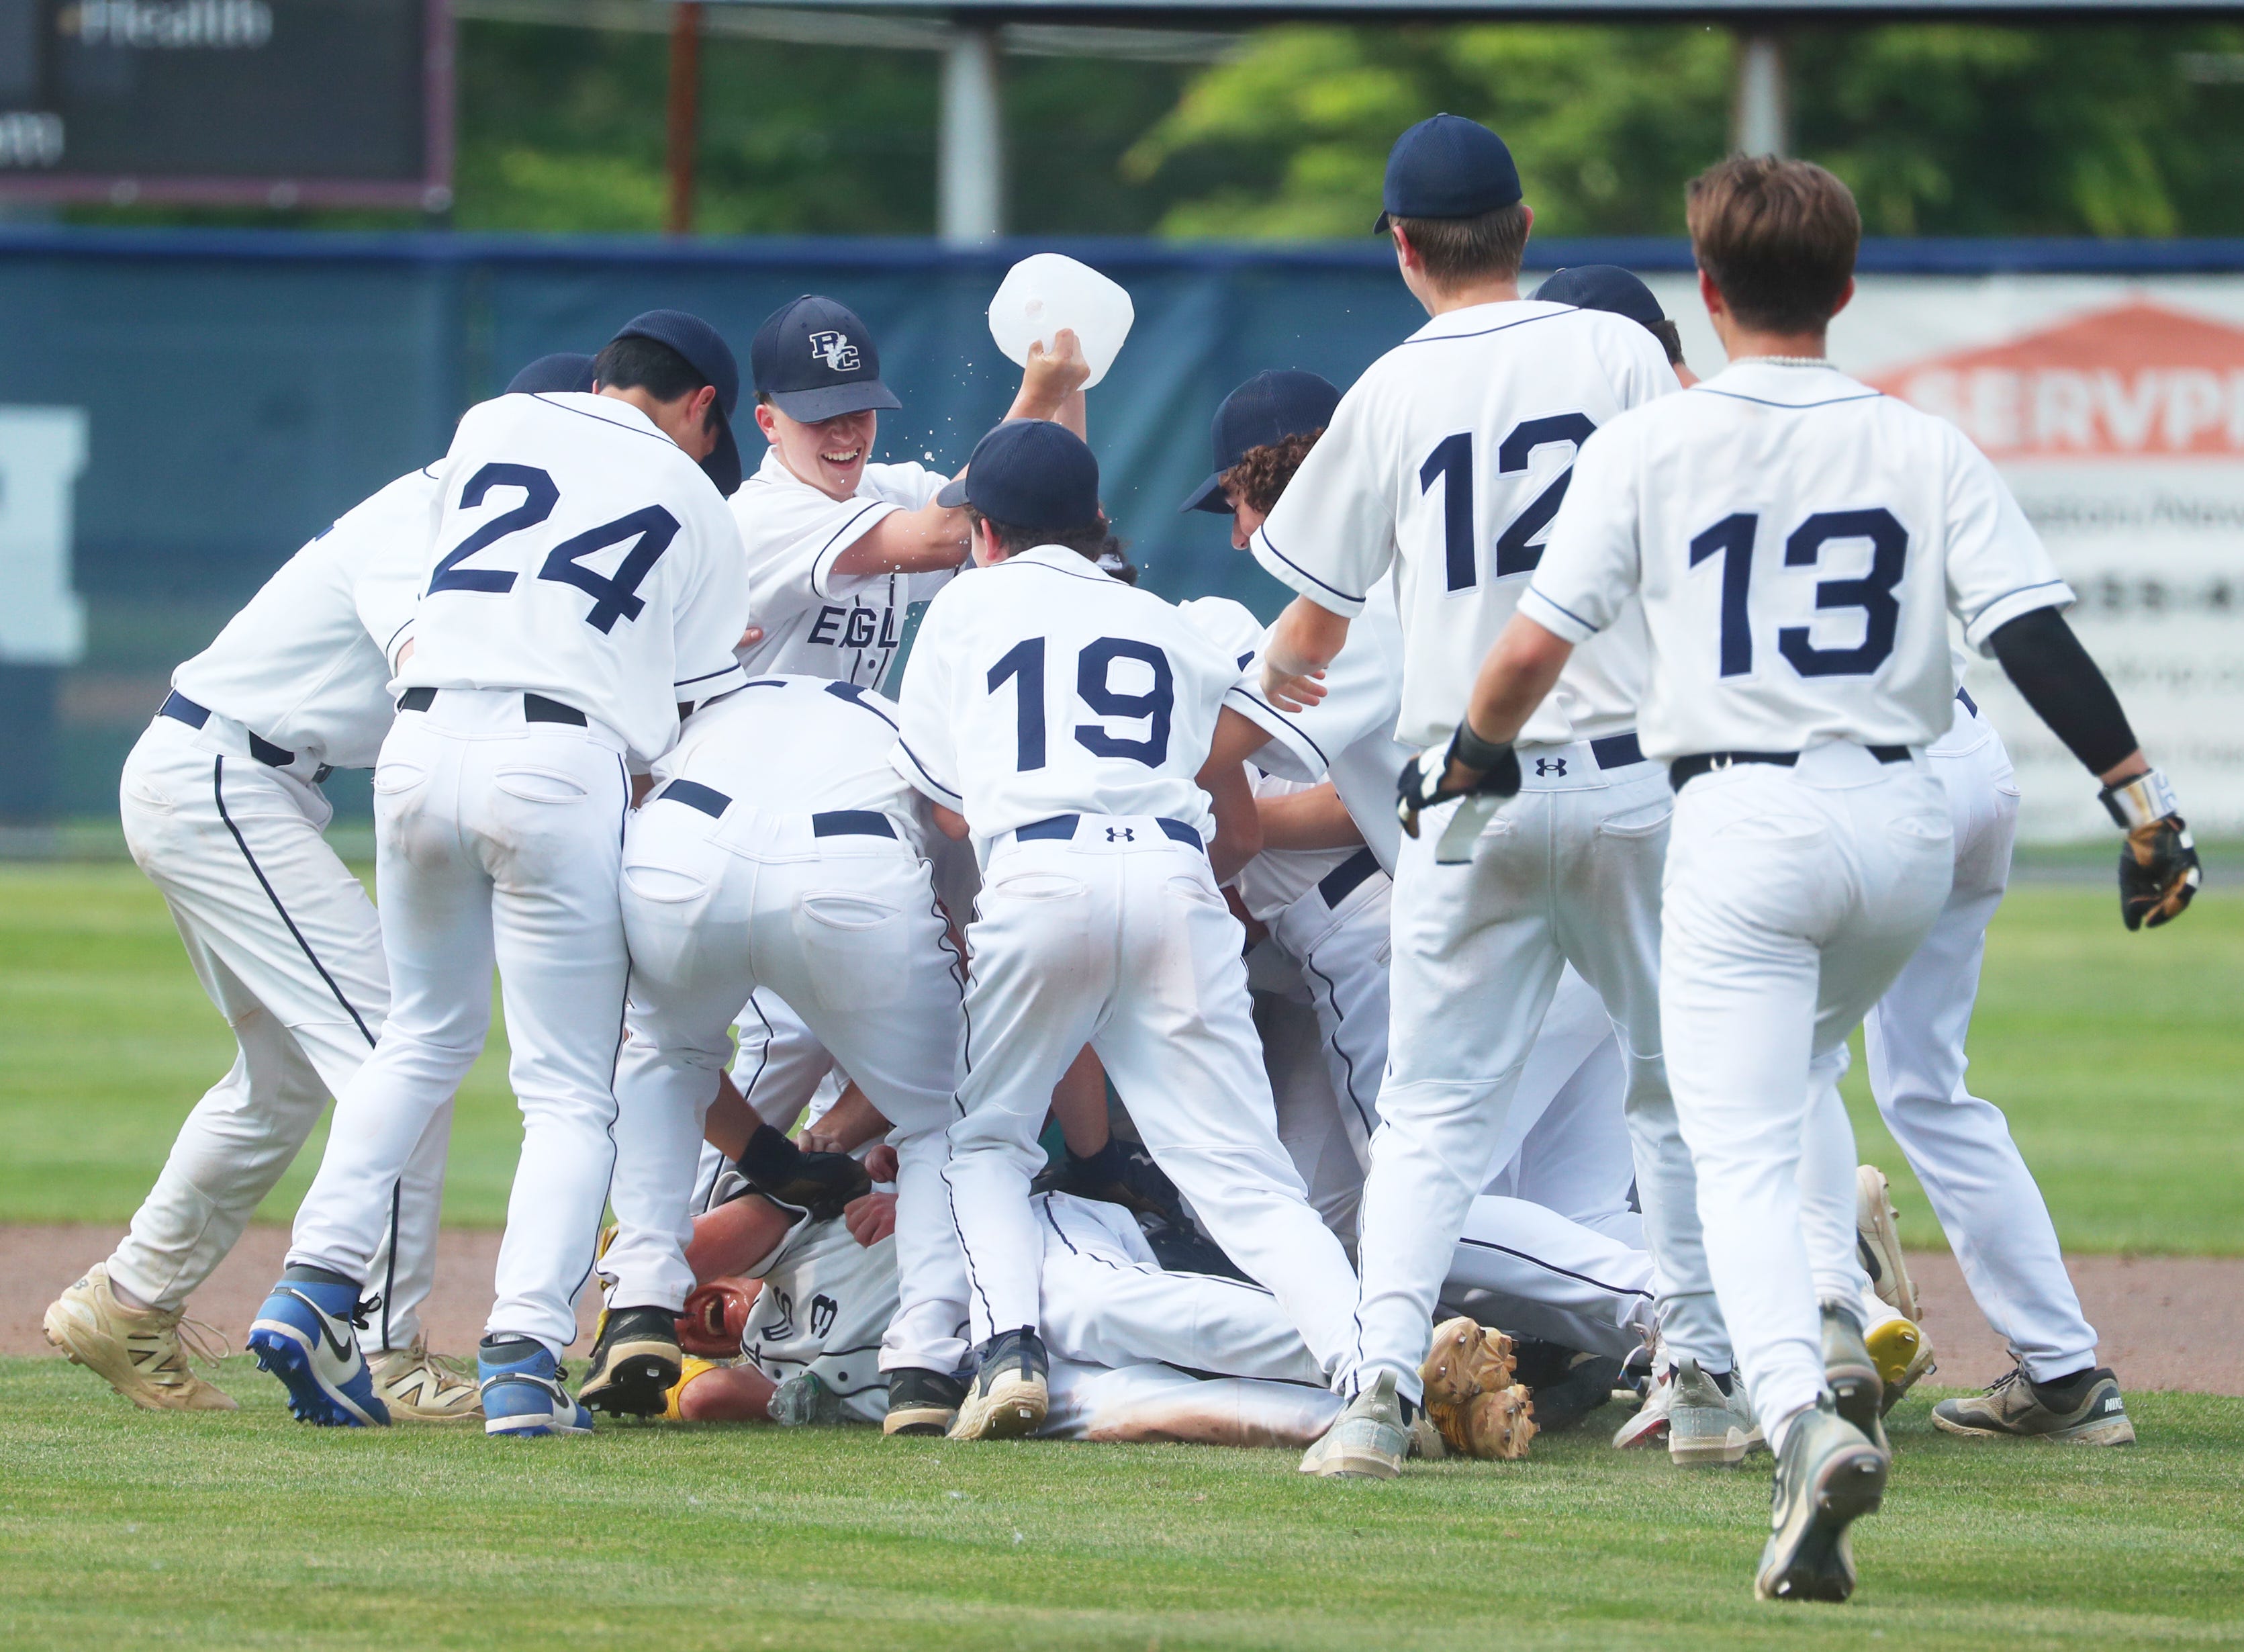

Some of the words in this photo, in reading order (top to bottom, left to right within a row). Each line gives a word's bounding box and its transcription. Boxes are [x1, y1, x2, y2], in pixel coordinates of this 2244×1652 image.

[426, 463, 682, 635] 24
[1419, 412, 1597, 592] 12
[807, 605, 898, 648] EGL
[1690, 507, 1909, 678] 13
[987, 636, 1174, 772] 19
[810, 1293, 838, 1339] 3
[2104, 1397, 2123, 1413] NIKE
